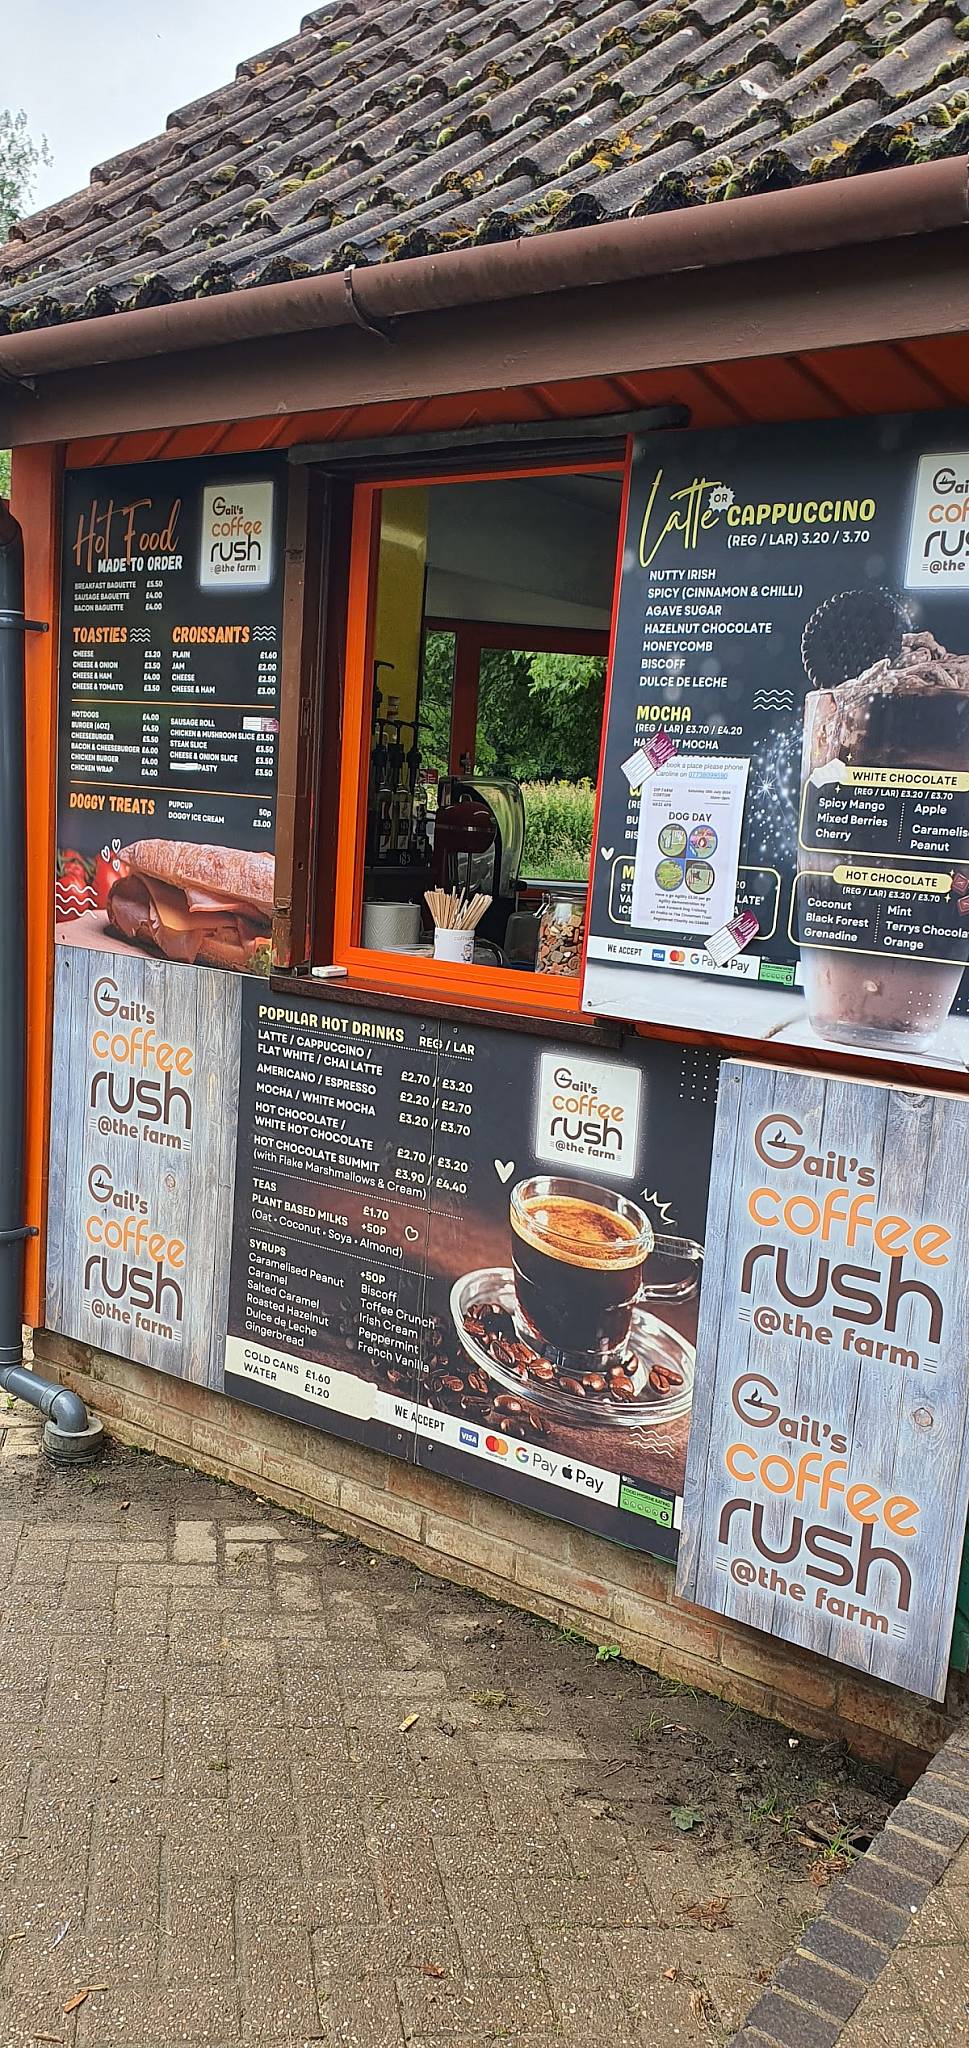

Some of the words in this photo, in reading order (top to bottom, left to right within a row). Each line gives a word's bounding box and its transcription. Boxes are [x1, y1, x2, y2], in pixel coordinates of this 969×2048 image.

[212, 496, 243, 516] Gail's
[714, 493, 727, 503] OR
[639, 468, 721, 567] Latte
[727, 499, 876, 527] CAPPUCCINO
[72, 499, 114, 573] Hot
[123, 498, 181, 566] Food
[212, 516, 262, 537] coffee
[210, 535, 261, 562] rush
[727, 535, 757, 548] (REG
[769, 533, 799, 546] LAR)
[801, 532, 830, 544] 3.20
[842, 531, 870, 543] 3.70
[98, 558, 126, 573] MADE
[131, 558, 144, 571] TO
[147, 555, 183, 571] ORDER
[214, 564, 234, 574] @the
[237, 564, 256, 572] farm
[649, 570, 685, 581] NUTTY
[688, 569, 716, 580] IRISH
[648, 587, 679, 599] SPICY
[682, 586, 748, 599] (CINNAMON
[750, 586, 758, 597] &
[761, 585, 803, 598] CHILLI)
[74, 604, 94, 612] BACON
[646, 605, 682, 616] AGAVE
[684, 605, 722, 616] SUGAR
[72, 627, 127, 643] TOASTIES
[172, 626, 250, 643] CROISSANTS
[644, 623, 701, 634] HAZELNUT
[702, 622, 772, 634] CHOCOLATE
[643, 641, 713, 652] HONEYCOMB
[641, 658, 686, 670] BISCOFF
[639, 676, 674, 687] DULCE
[676, 676, 690, 687] DE
[692, 676, 727, 688] LECHE
[636, 705, 692, 722] MOCHA
[71, 764, 95, 772] CHICKEN
[853, 772, 887, 782] WHITE
[889, 773, 958, 786] CHOCOLATE
[69, 793, 105, 811] DOGGY
[109, 797, 155, 815] TREATS
[169, 801, 193, 809] PUPCUP
[818, 798, 847, 810] Spicy
[850, 800, 885, 812] Mango
[914, 804, 947, 816] Apple
[168, 812, 190, 820] DOGGY
[202, 815, 224, 823] CREAM
[669, 812, 690, 820] DOG
[692, 813, 712, 822] DAY
[817, 814, 848, 824] Mixed
[850, 815, 888, 827] Berries
[816, 829, 851, 841] Cherry
[910, 841, 950, 851] Peanut
[846, 871, 868, 882] HOT
[871, 873, 937, 887] CHOCOLATE
[808, 898, 852, 911] Coconut
[888, 906, 912, 917] Mint
[806, 913, 833, 924] Black
[836, 917, 869, 928] Forest
[804, 928, 858, 942] Grenadine
[884, 937, 924, 950] Orange
[607, 944, 617, 953] WE
[618, 946, 642, 957] ACCEPT
[731, 960, 750, 974] Pay
[94, 977, 155, 1025] Gail's
[259, 1006, 318, 1028] POPULAR
[321, 1015, 349, 1032] HOT
[352, 1021, 405, 1042] DRINKS
[92, 1027, 194, 1076] coffee
[554, 1067, 598, 1094] Gail's
[91, 1071, 192, 1129] rush
[552, 1094, 624, 1122] coffee
[98, 1115, 139, 1140] @the
[143, 1124, 182, 1150] farm
[255, 1116, 286, 1133] WHITE
[288, 1123, 308, 1138] HOT
[310, 1127, 374, 1151] CHOCOLATE
[550, 1116, 623, 1150] rush
[254, 1135, 275, 1150] HOT
[276, 1140, 336, 1163] CHOCOLATE
[338, 1154, 380, 1173] SUMMIT
[556, 1140, 584, 1153] @the
[588, 1146, 615, 1160] farm
[754, 1113, 875, 1188] Gail's
[253, 1149, 277, 1162] (with
[279, 1154, 303, 1168] Flake
[305, 1161, 375, 1187] Marshmallows
[378, 1179, 385, 1188] &
[387, 1181, 427, 1199] Cream)
[88, 1165, 148, 1214] Gail's
[253, 1178, 277, 1192] TEAS
[363, 1206, 389, 1221] £1.70
[252, 1194, 282, 1210] PLANT
[284, 1202, 315, 1218] BASED
[318, 1210, 348, 1226] MILKS
[361, 1223, 387, 1236] +50P
[748, 1187, 952, 1267] coffee
[86, 1215, 185, 1268] coffee
[249, 1239, 287, 1257] SYRUPS
[360, 1271, 386, 1284] +50P
[249, 1253, 313, 1276] Caramelised
[310, 1269, 344, 1288] Peanut
[84, 1254, 183, 1321] rush
[248, 1266, 287, 1285] Caramel
[247, 1280, 277, 1297] Salted
[279, 1288, 320, 1309] Caramel
[361, 1284, 398, 1302] Biscoff
[741, 1243, 944, 1345] rush
[91, 1298, 131, 1324] @the
[135, 1311, 173, 1340] farm
[246, 1307, 273, 1324] Dulce
[274, 1315, 287, 1327] de
[288, 1319, 318, 1337] Leche
[247, 1294, 284, 1313] Roasted
[287, 1305, 329, 1327] Hazelnut
[360, 1298, 394, 1316] Toffee
[396, 1309, 435, 1330] Crunch
[245, 1320, 304, 1347] Gingerbread
[359, 1313, 381, 1329] Irish
[383, 1321, 418, 1339] Cream
[358, 1327, 419, 1354] Peppermint
[753, 1306, 833, 1347] @the
[841, 1327, 920, 1372] farm
[244, 1349, 270, 1365] COLD
[272, 1358, 299, 1374] CANS
[305, 1369, 331, 1385] £1.60
[358, 1341, 393, 1361] French
[395, 1351, 430, 1373] Vanilla
[244, 1363, 277, 1381] WATER
[304, 1384, 330, 1399] £1.20
[395, 1404, 408, 1417] WE
[411, 1409, 445, 1433] ACCEPT
[732, 1372, 847, 1454] Gail's
[461, 1432, 477, 1443] VISA
[533, 1453, 558, 1477] Pay
[575, 1469, 604, 1494] Pay
[725, 1443, 920, 1537] coffee
[718, 1497, 911, 1612] rush
[730, 1558, 807, 1602] @the
[815, 1587, 889, 1635] farm
